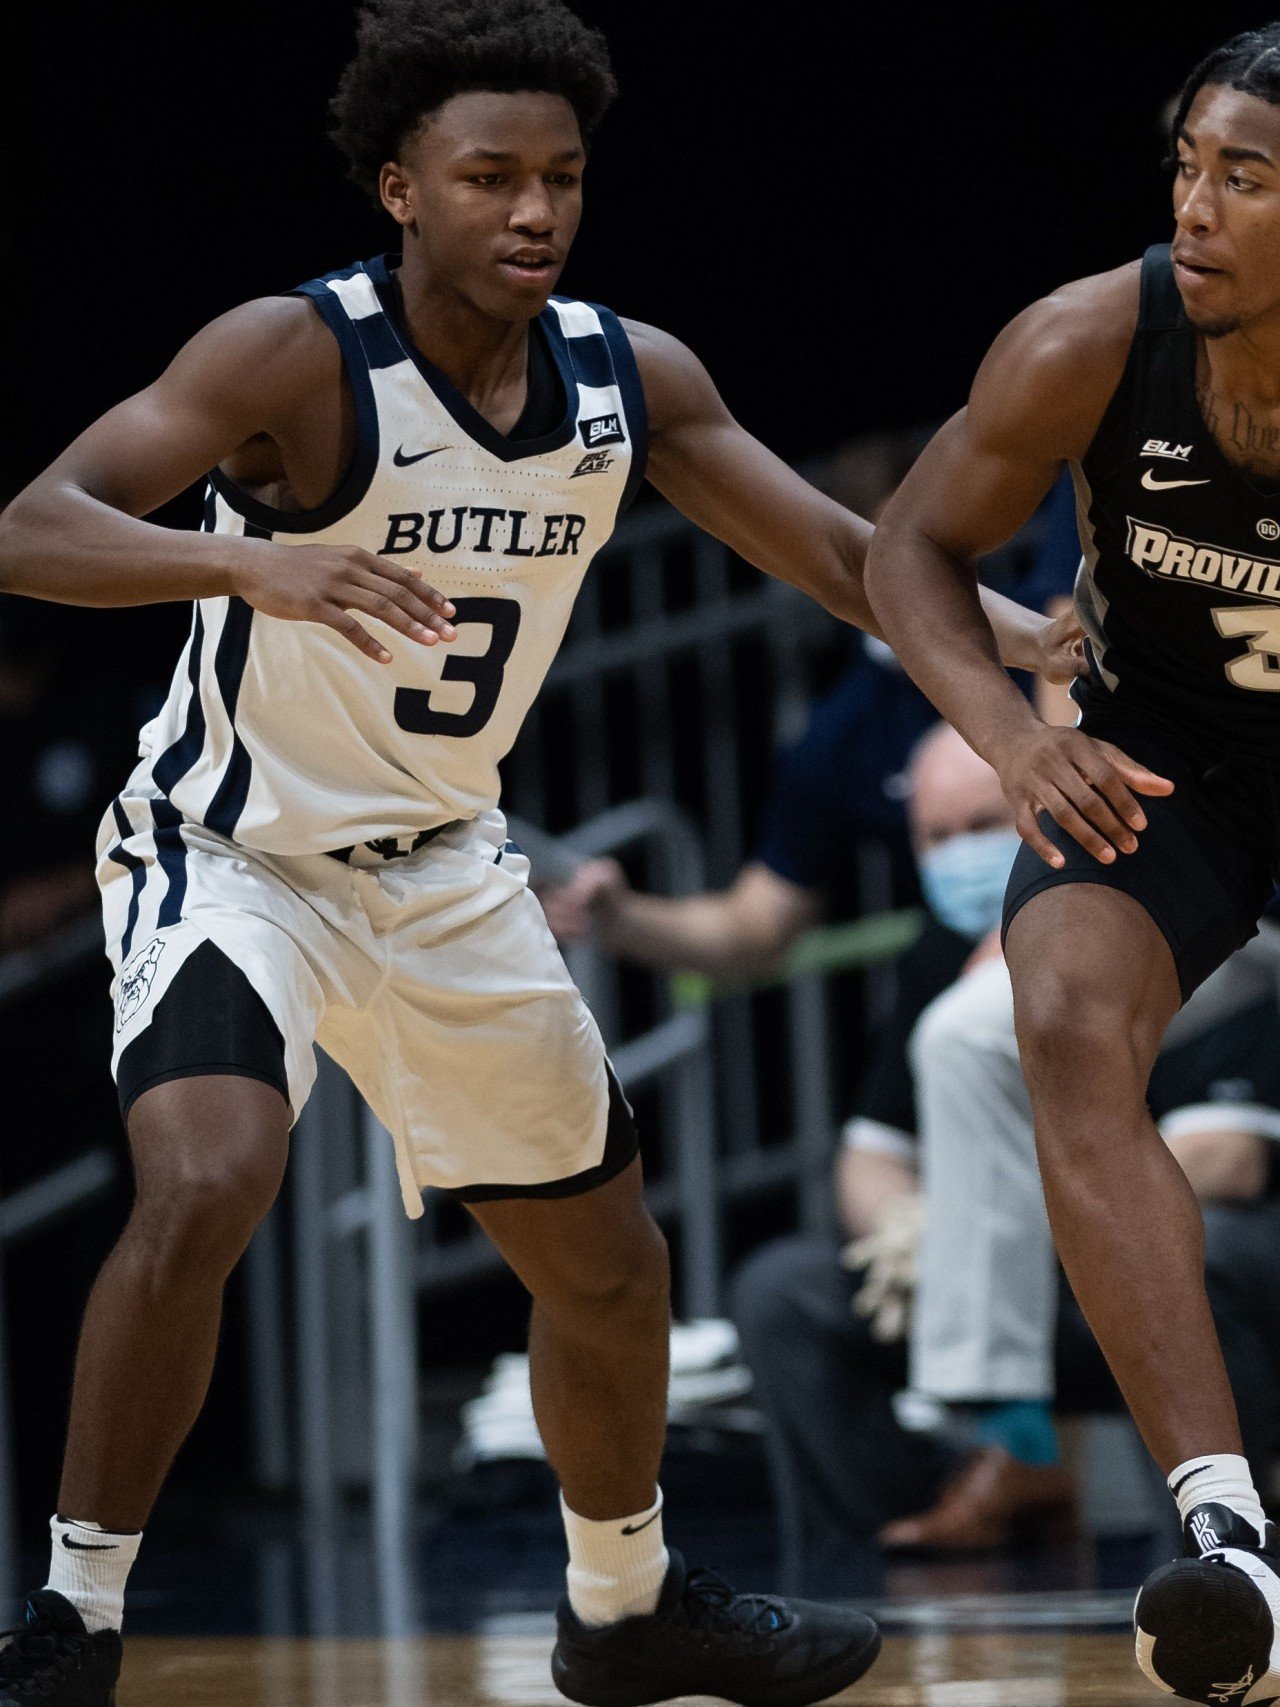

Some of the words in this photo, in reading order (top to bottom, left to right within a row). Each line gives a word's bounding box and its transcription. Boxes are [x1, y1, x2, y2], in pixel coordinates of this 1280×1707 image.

[590, 418, 618, 437] BLM
[582, 449, 610, 462] BIG
[1142, 439, 1194, 458] BLM
[573, 459, 615, 474] EAST
[377, 506, 586, 557] BUTLER
[1260, 523, 1276, 536] DG
[394, 597, 521, 738] 3
